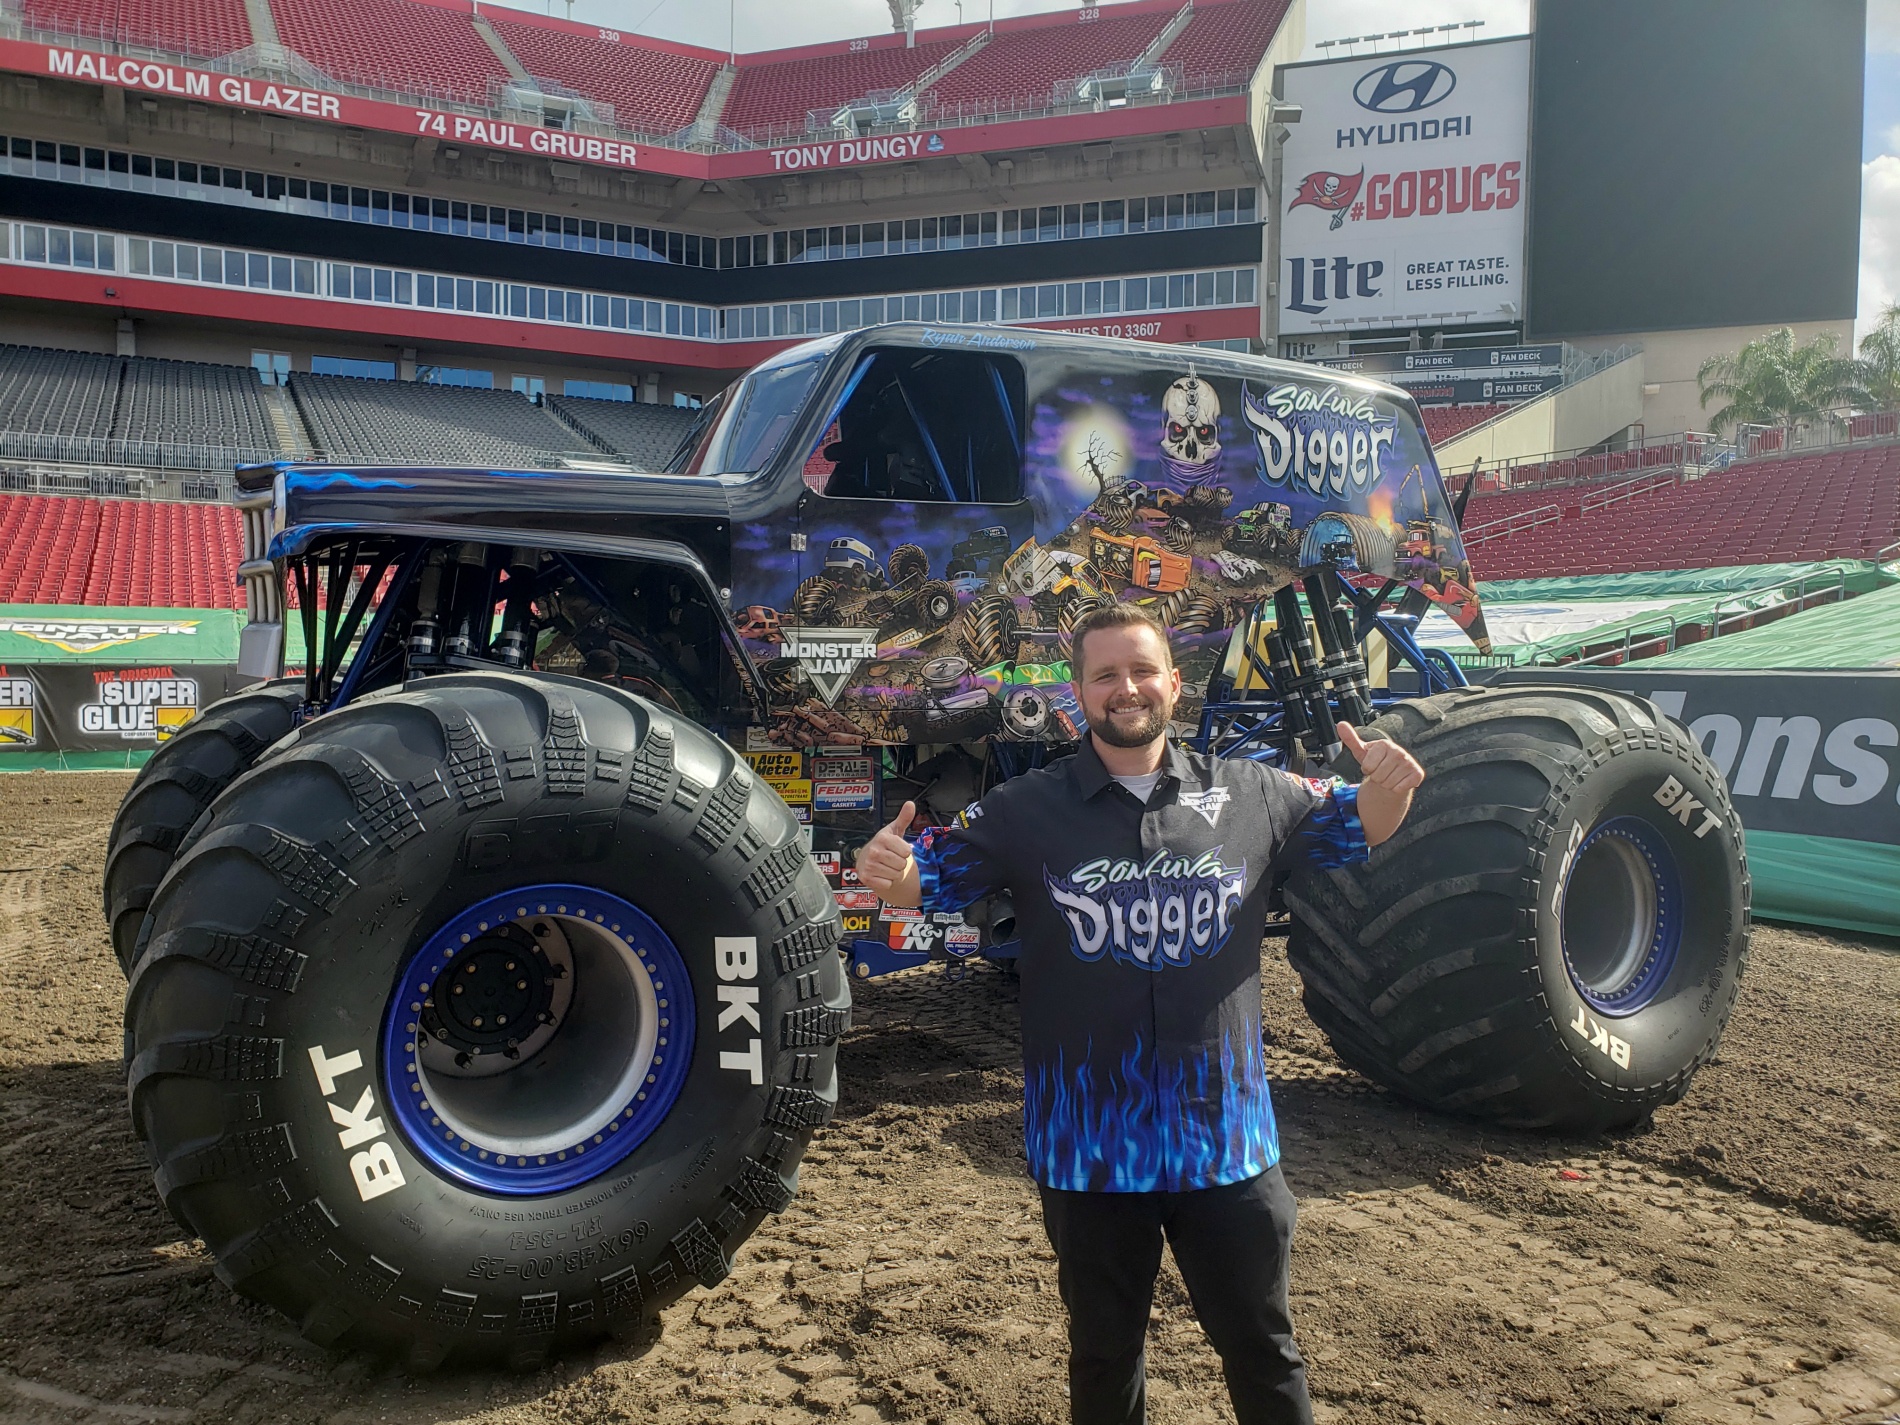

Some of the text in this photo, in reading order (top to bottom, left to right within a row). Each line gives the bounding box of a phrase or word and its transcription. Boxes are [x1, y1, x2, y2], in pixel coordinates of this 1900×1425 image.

[1078, 8, 1100, 20] 328
[599, 29, 620, 42] 330
[849, 40, 869, 51] 329
[49, 48, 340, 119] MALCOLM GLAZER
[415, 111, 636, 166] 74 PAUL GRUBER
[1336, 115, 1471, 149] HYUNDAI
[771, 134, 923, 170] TONY DUNGY
[1350, 160, 1521, 221] #GOBUCS
[1406, 256, 1510, 275] GREAT TASTE.
[1284, 256, 1384, 315] Lite
[1406, 273, 1509, 291] LESS FILLING.
[919, 328, 966, 348] Ryan
[1103, 325, 1121, 338] TO
[1125, 321, 1161, 337] 33607
[1342, 361, 1363, 369] DECK
[1415, 356, 1453, 366] FAN DECK
[1518, 352, 1541, 361] DECK
[1495, 383, 1542, 393] FAN DECK
[1244, 396, 1395, 494] Digger
[780, 642, 877, 658] MONSTER
[93, 666, 175, 684] THE ORIGINAL
[808, 659, 852, 674] JAM
[103, 680, 196, 706] SUPER
[83, 706, 154, 730] GLUE
[757, 754, 793, 765] Auto
[819, 761, 868, 773] DERALE
[755, 765, 799, 776] Meter
[1652, 774, 1723, 839] BKT
[1048, 877, 1243, 963] Digger
[949, 934, 977, 942] LUCAS
[714, 936, 764, 1086] BKT
[1570, 1006, 1631, 1071] BKT
[308, 1045, 407, 1202] BKT
